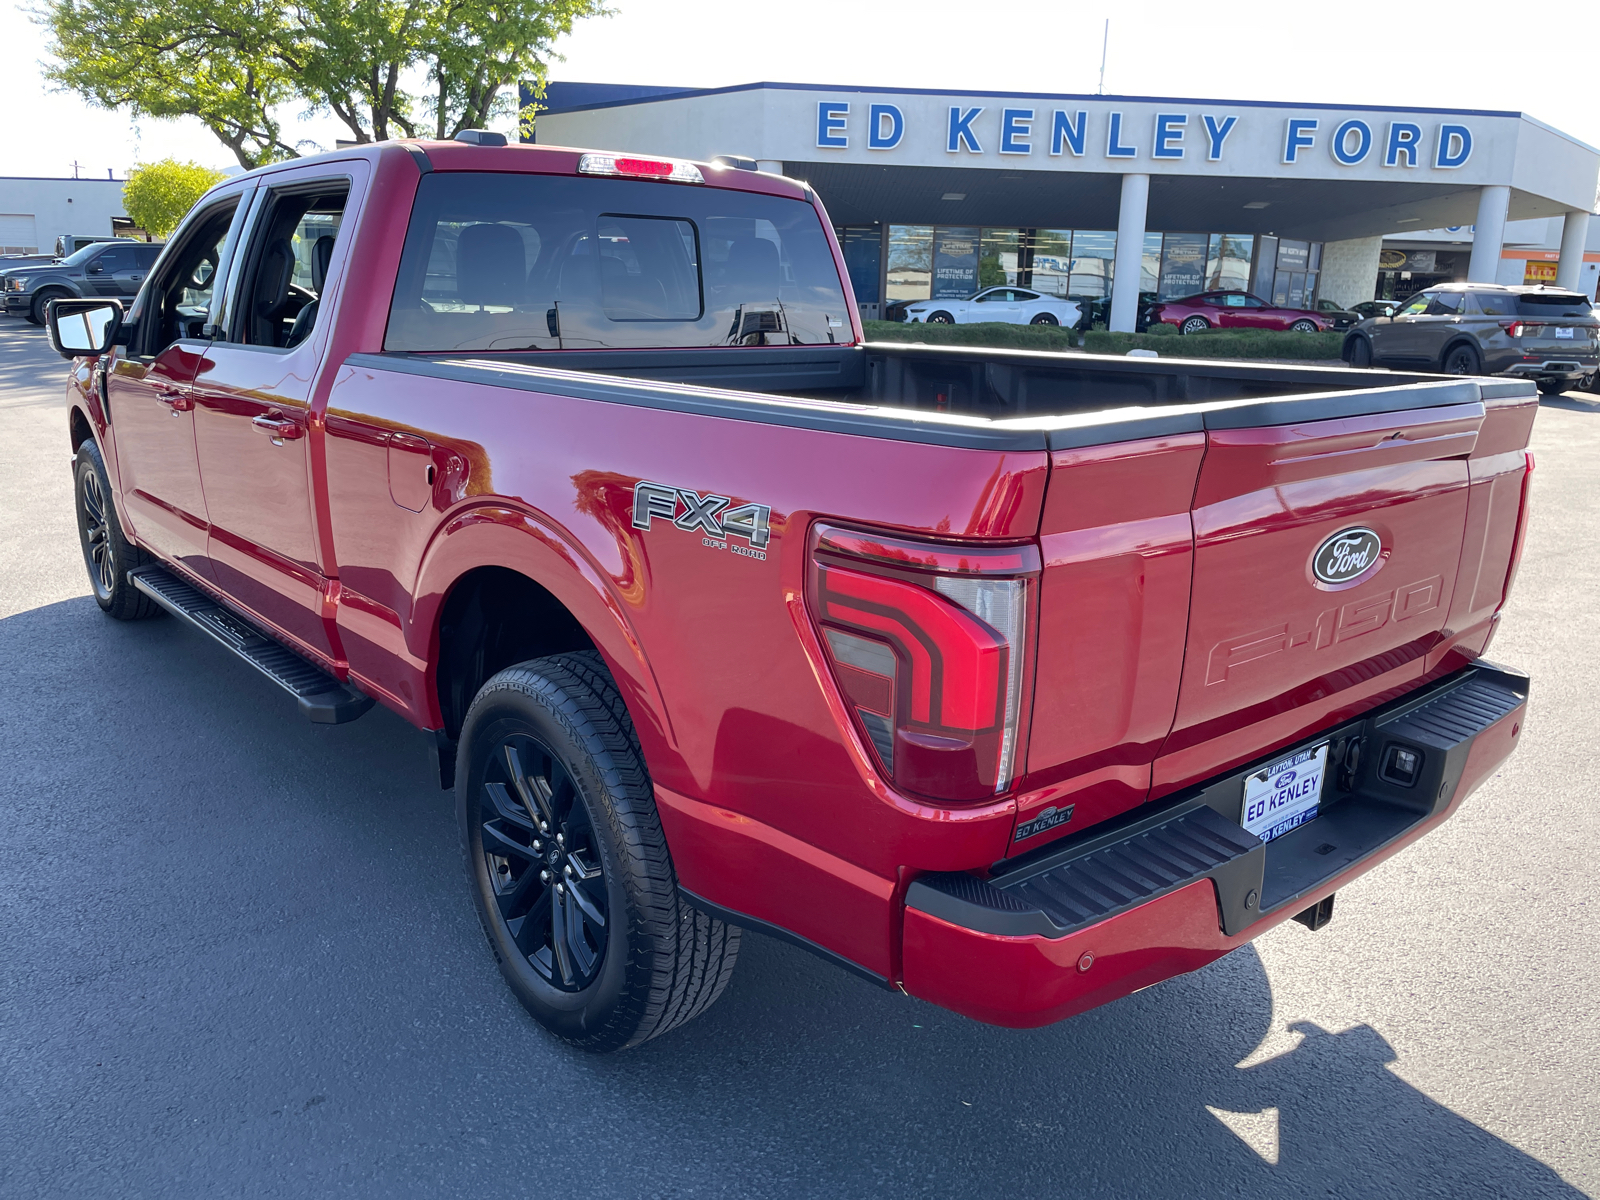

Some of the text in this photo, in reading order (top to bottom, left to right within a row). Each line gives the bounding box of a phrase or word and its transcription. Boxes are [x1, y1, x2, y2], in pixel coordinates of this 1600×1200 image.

[816, 101, 1474, 169] ED KENLEY FORD
[632, 480, 771, 550] FX4
[702, 538, 766, 561] OFF ROAD
[1326, 537, 1372, 576] Ford
[1204, 574, 1444, 686] F-150
[1295, 750, 1311, 765] UTAH
[1247, 800, 1265, 822] ED
[1269, 775, 1319, 811] KENLEY
[1015, 826, 1030, 839] ED
[1033, 809, 1073, 832] KENLEY
[1272, 812, 1305, 840] KENLEY
